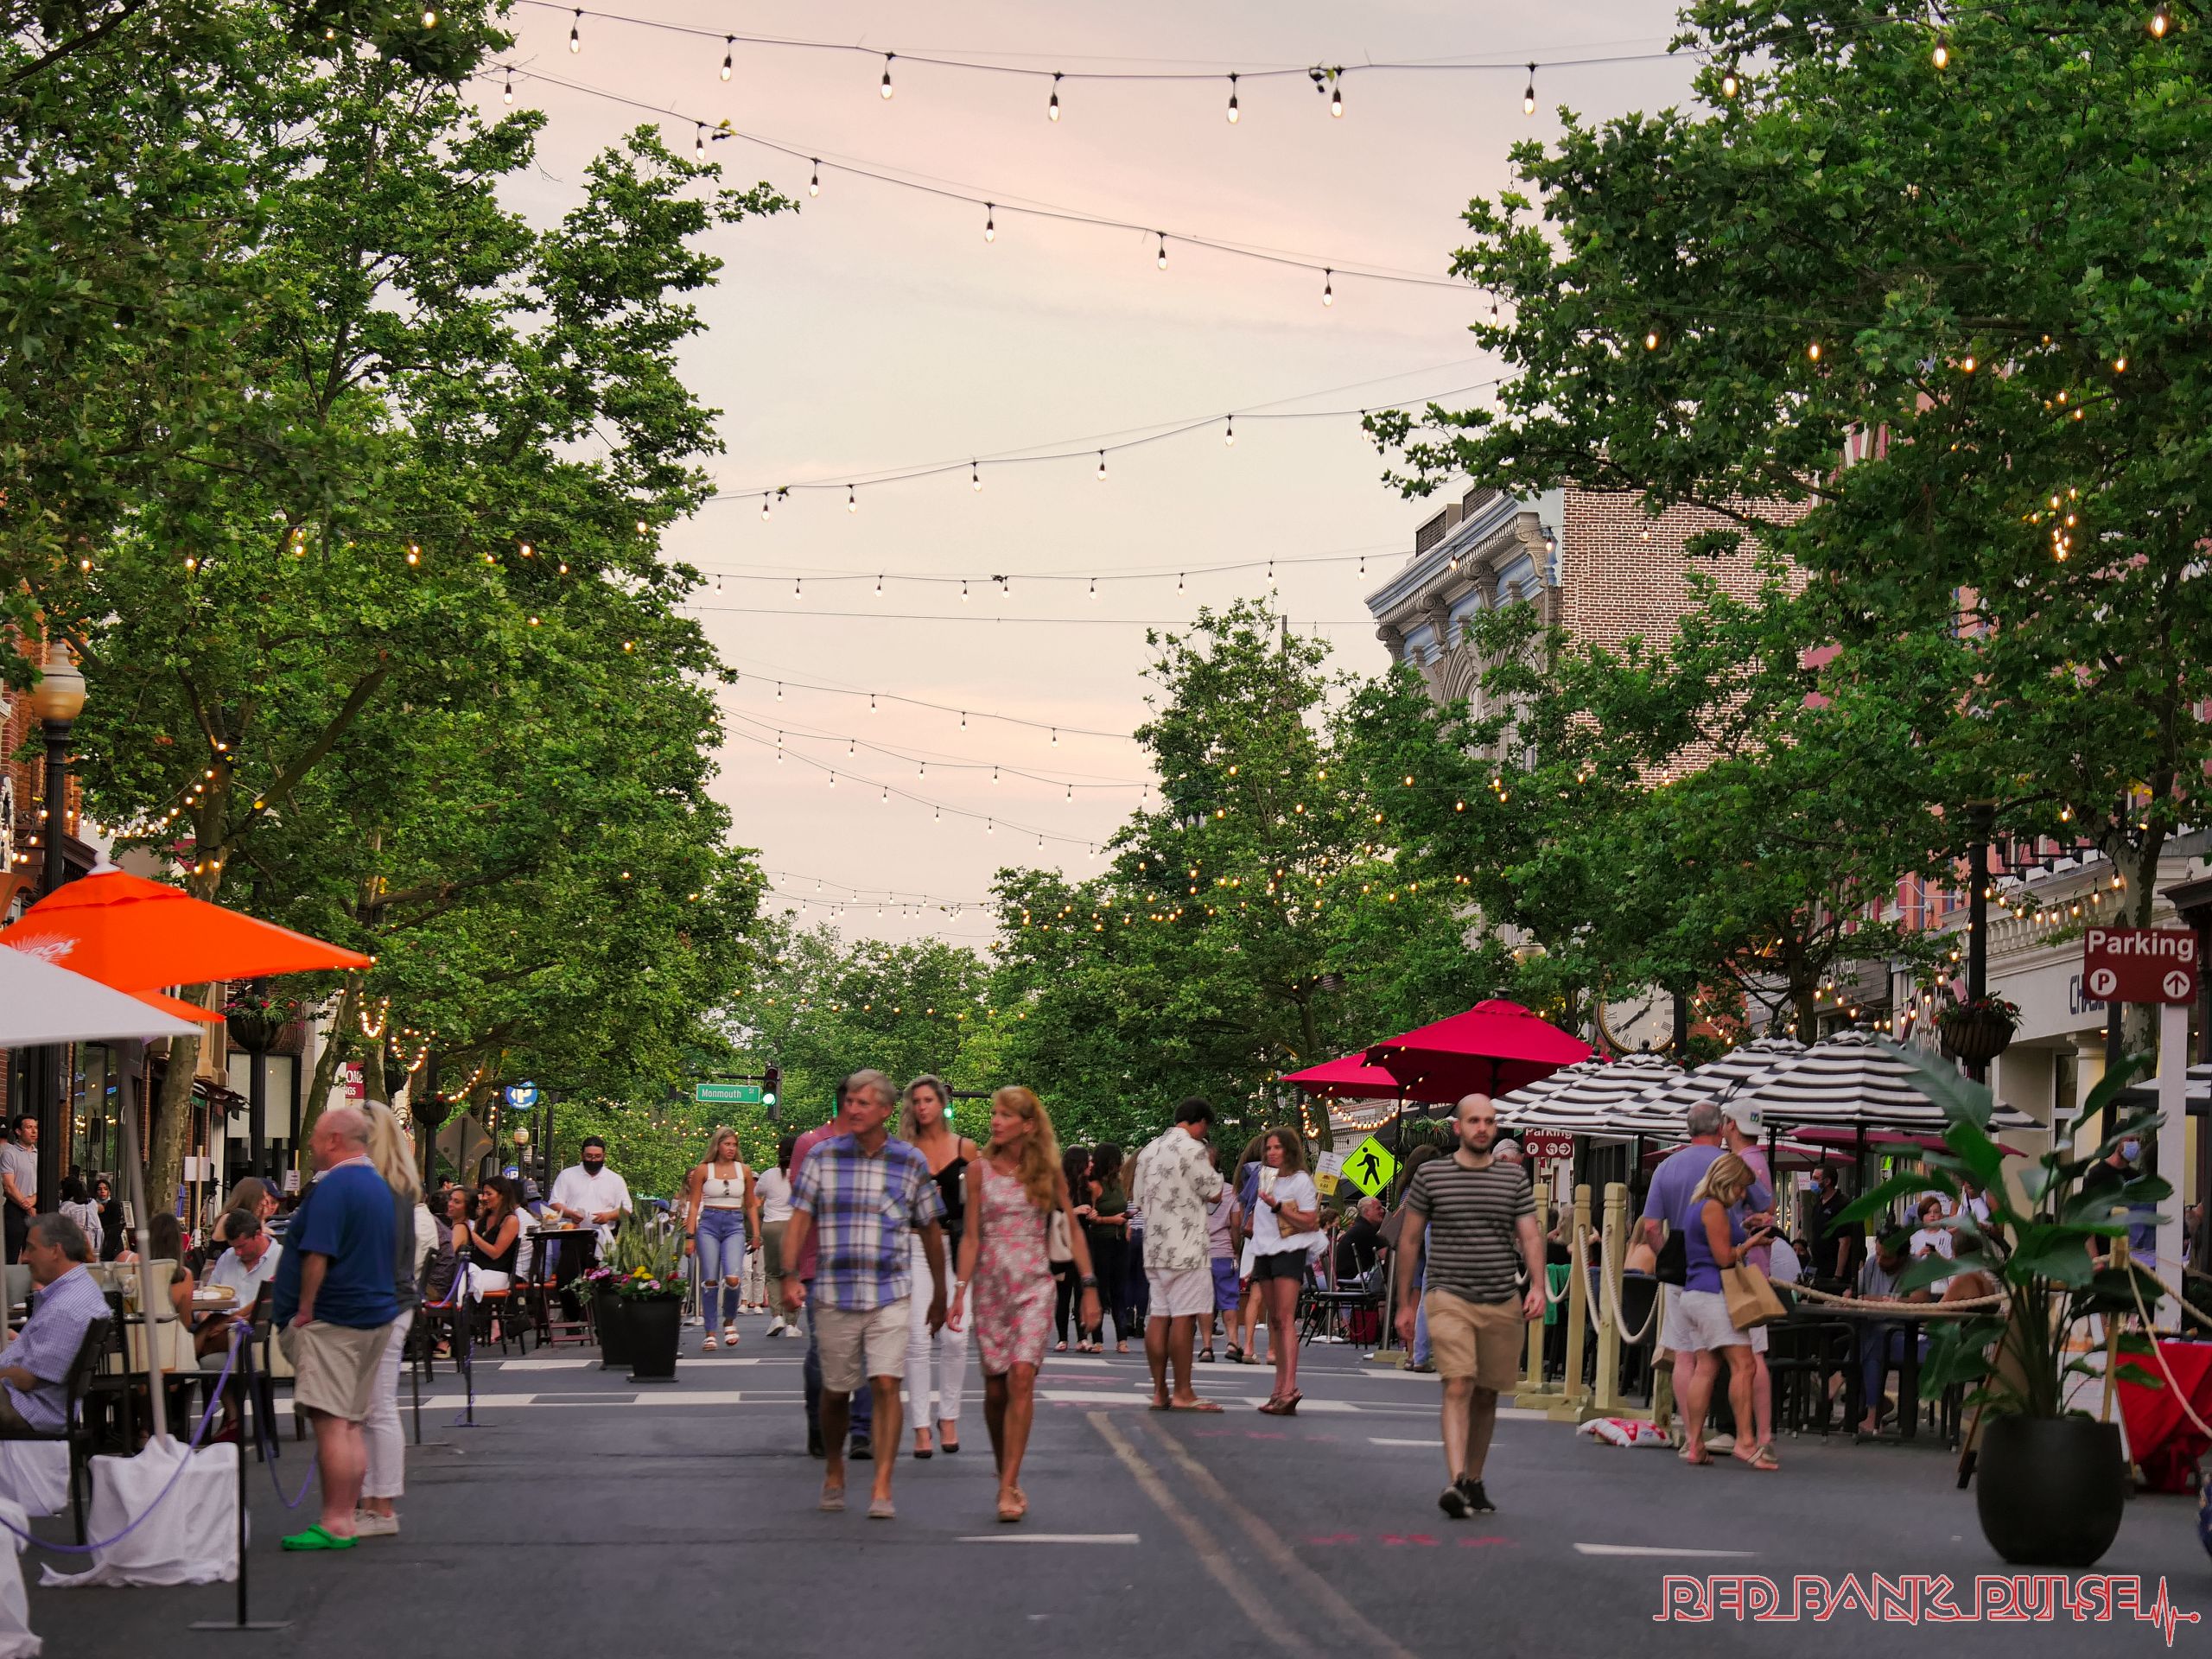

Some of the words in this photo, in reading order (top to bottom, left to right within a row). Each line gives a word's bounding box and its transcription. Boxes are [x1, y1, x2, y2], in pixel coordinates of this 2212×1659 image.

[2088, 930, 2194, 963] Parking
[2097, 972, 2110, 991] P
[702, 1089, 741, 1098] Monmouth
[1525, 1127, 1573, 1140] Parking
